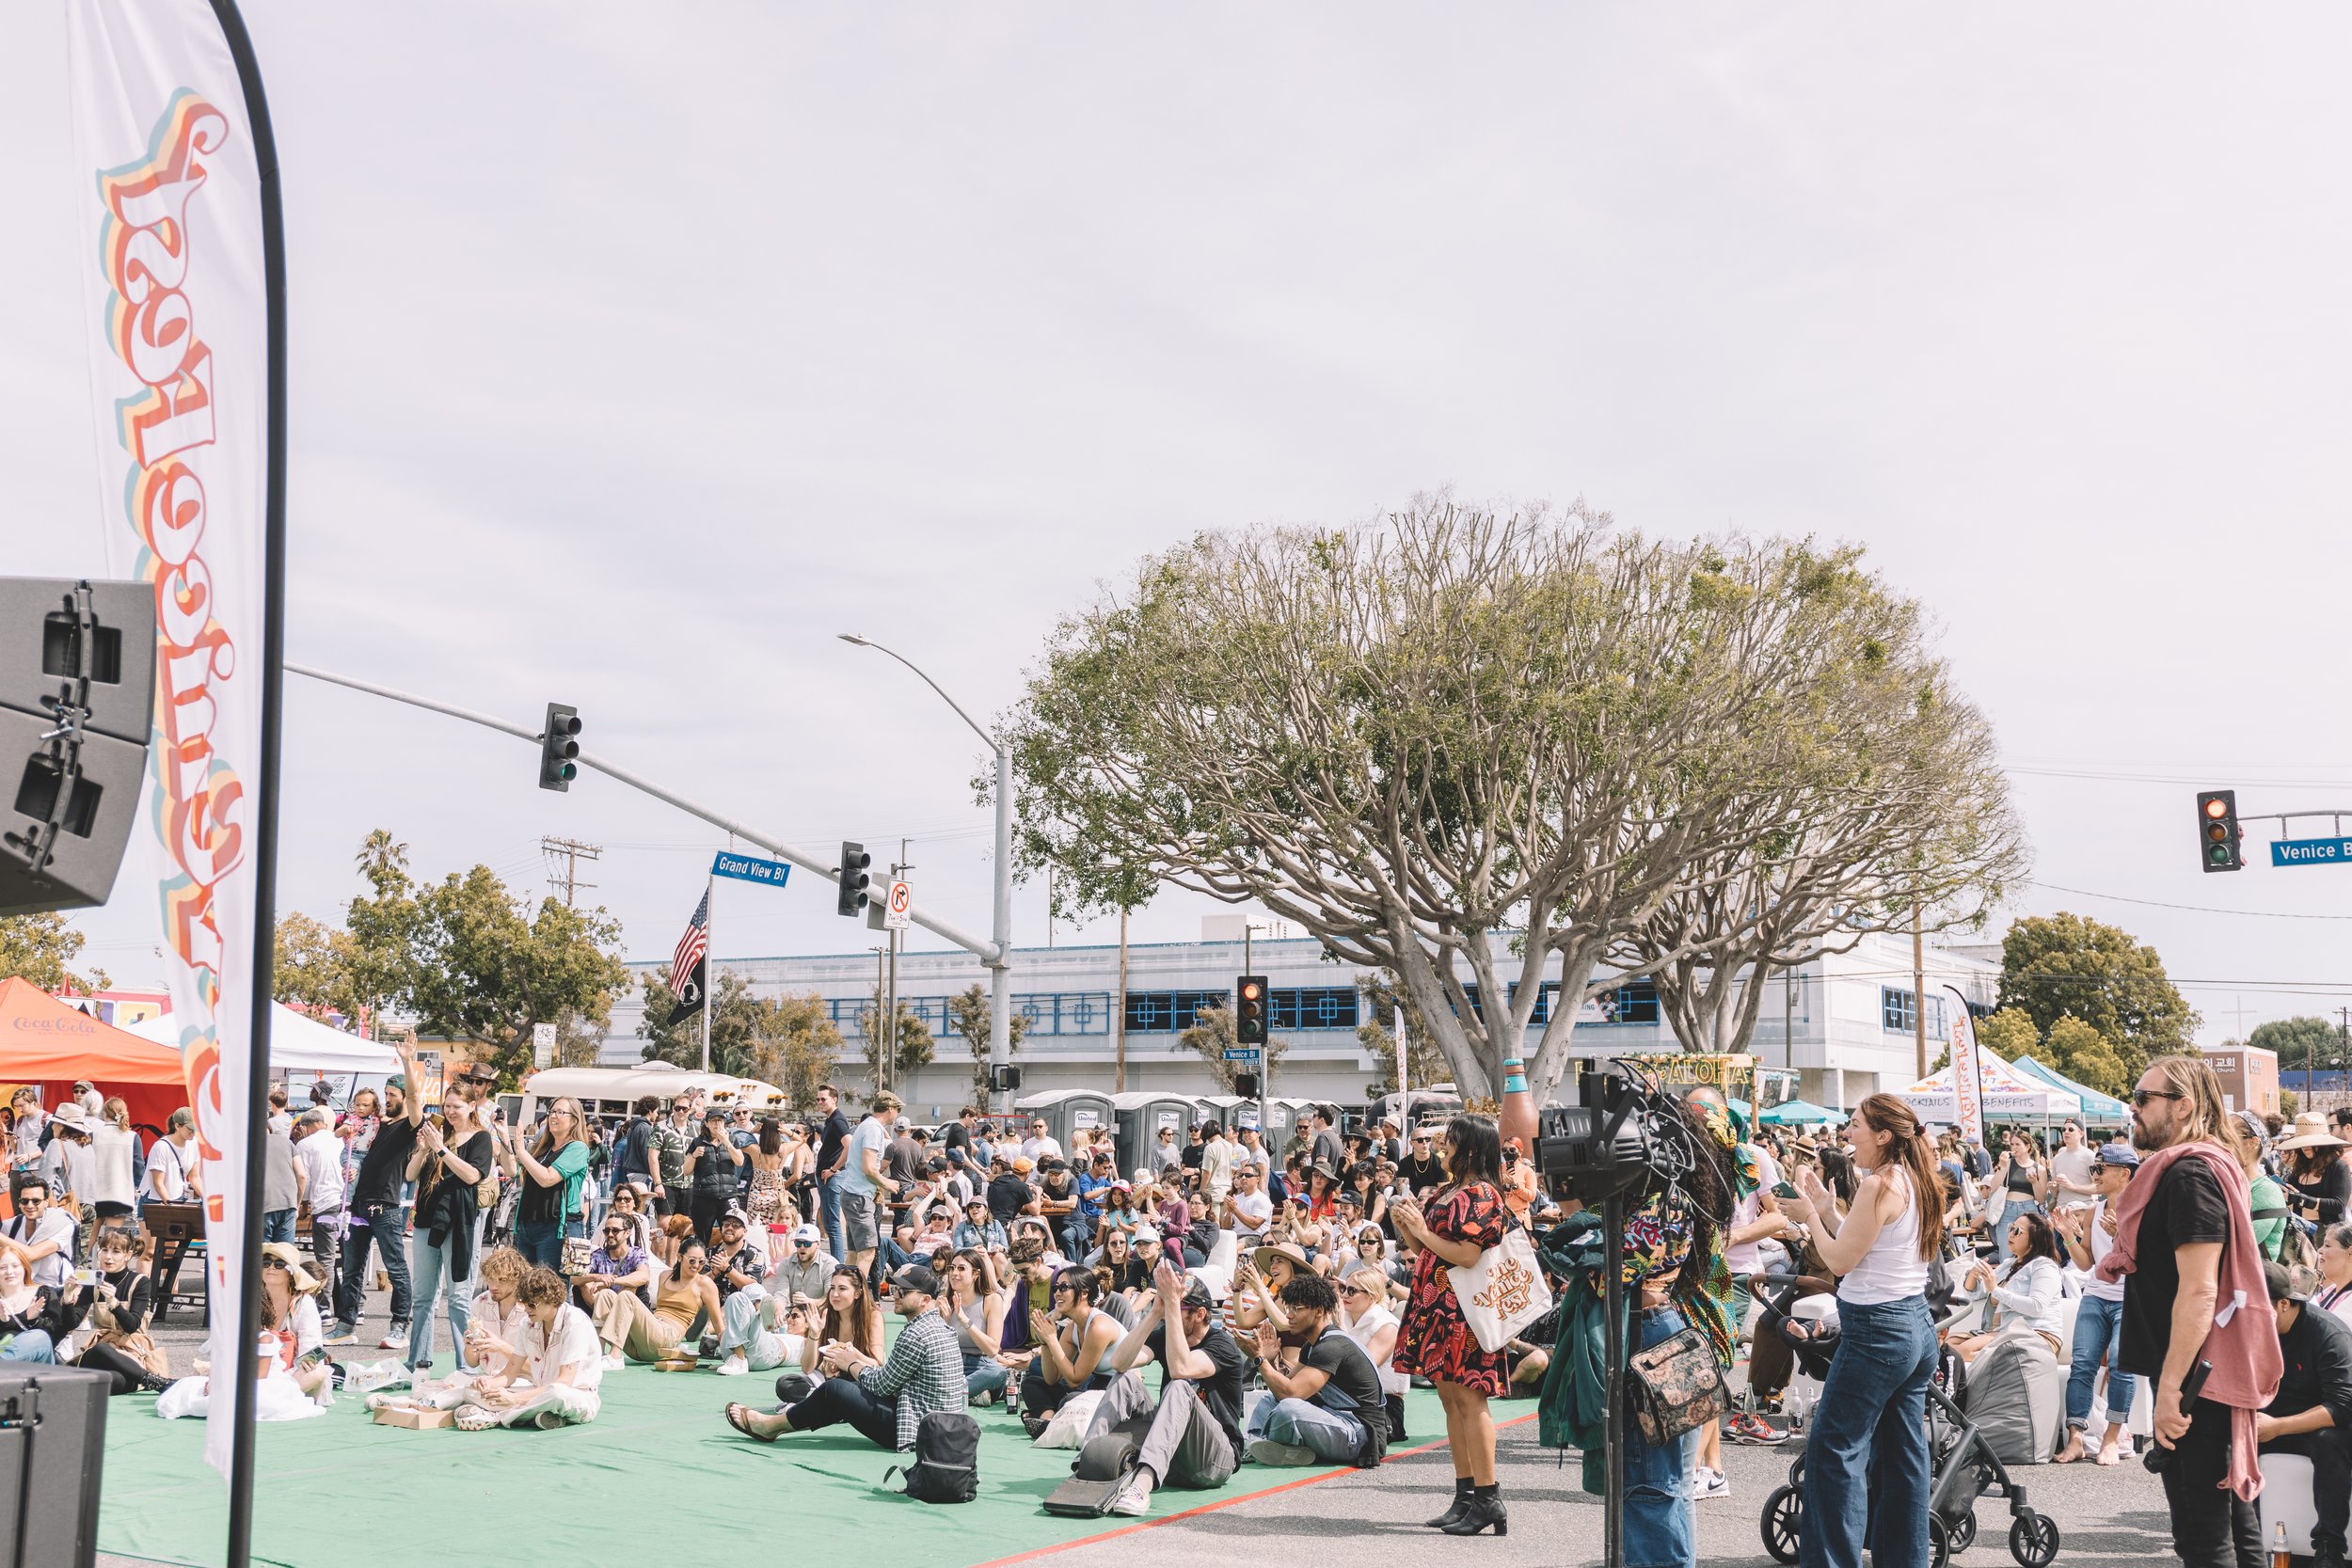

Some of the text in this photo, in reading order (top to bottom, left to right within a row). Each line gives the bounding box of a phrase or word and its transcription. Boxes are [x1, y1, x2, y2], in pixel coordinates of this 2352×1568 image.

[2280, 842, 2352, 860] Venice B
[719, 856, 786, 881] Grand View Bl
[1229, 1050, 1248, 1058] Venice
[2215, 1057, 2235, 1068] 교회
[1668, 1058, 1750, 1085] ALOHA
[1905, 1097, 2034, 1107] OCKTAILS BENEFITS
[1486, 1258, 1521, 1280] The
[1472, 1269, 1534, 1308] Venice
[1496, 1282, 1532, 1321] Fest
